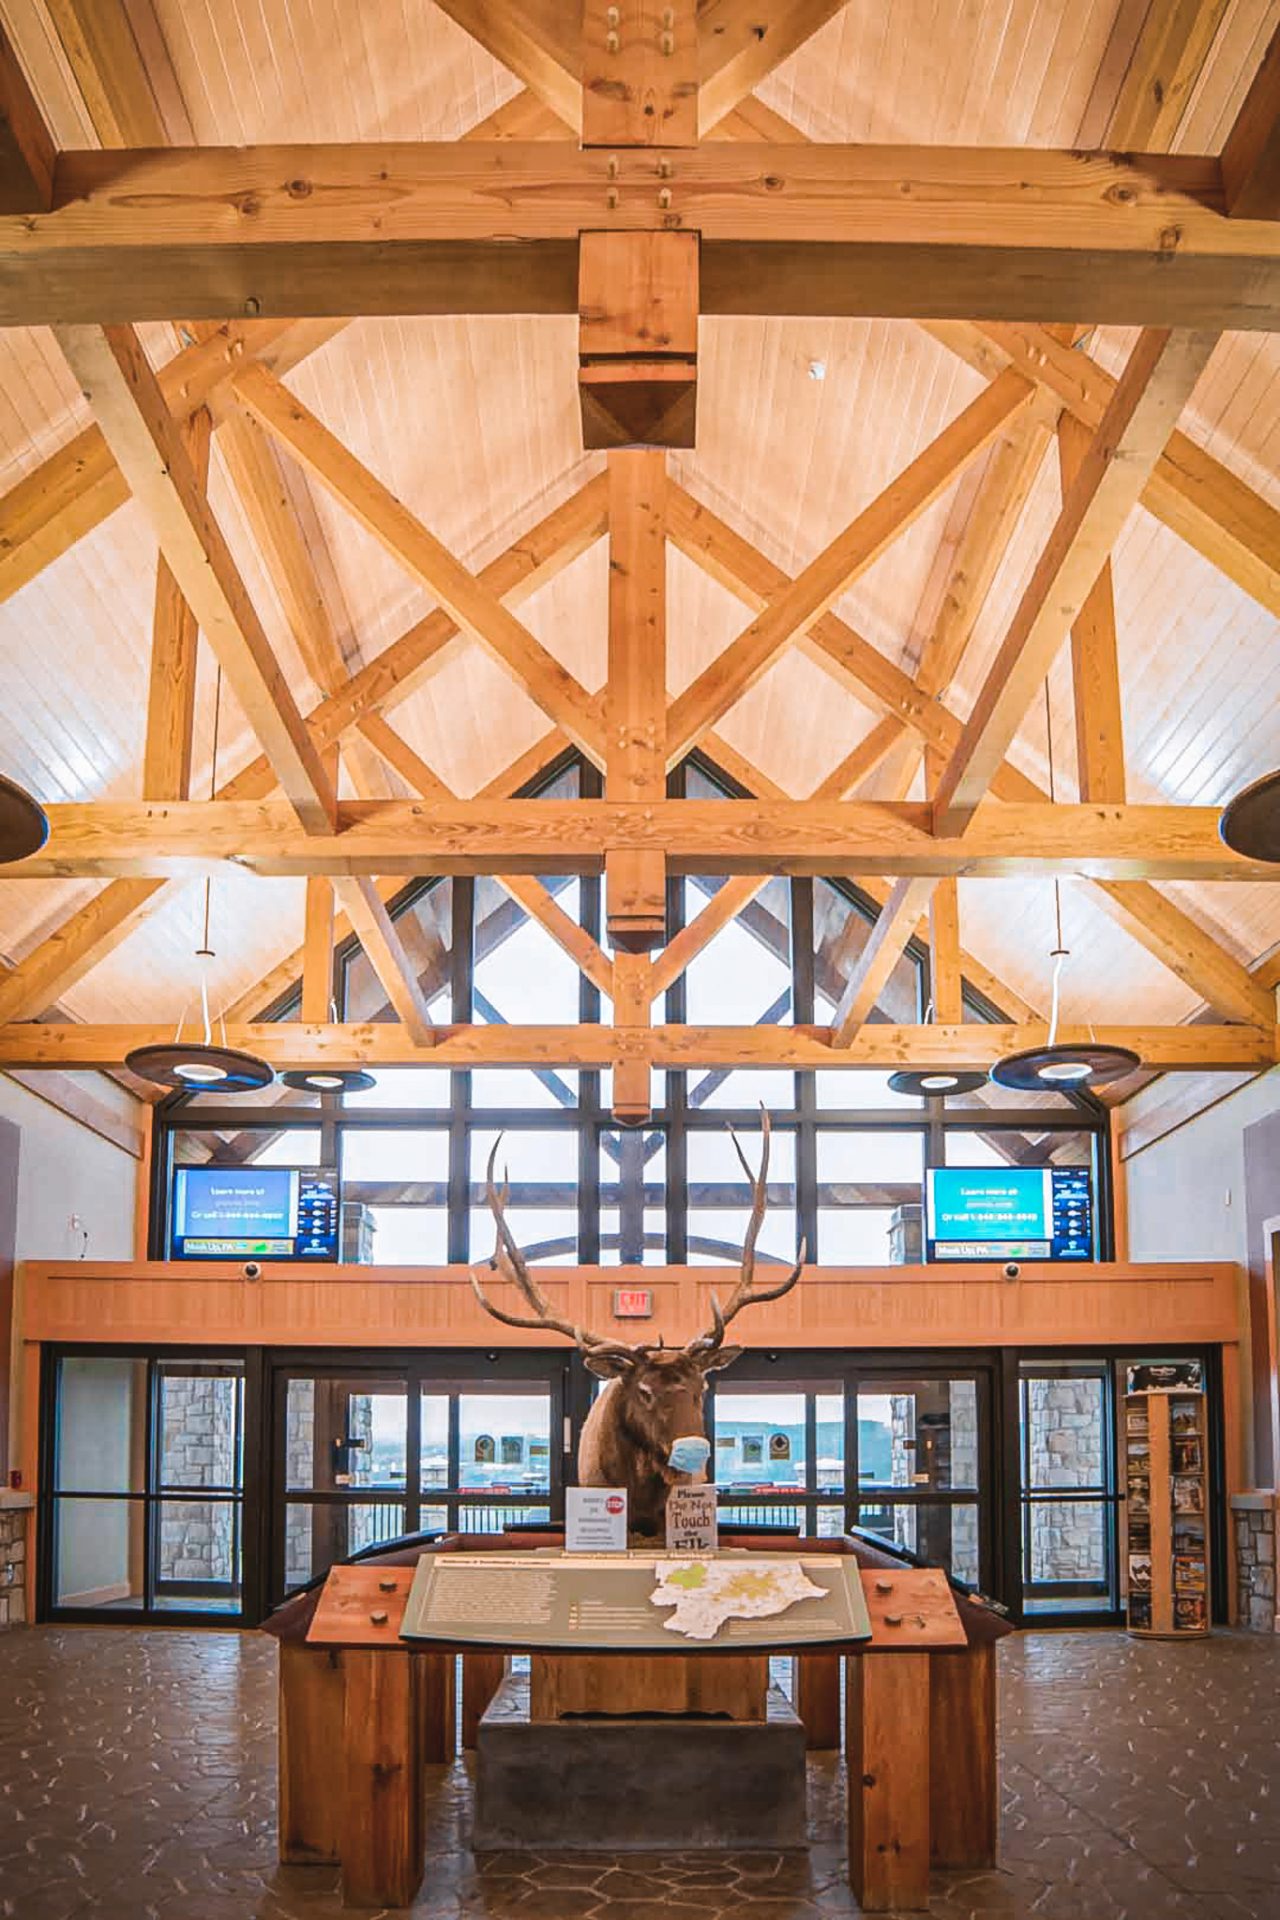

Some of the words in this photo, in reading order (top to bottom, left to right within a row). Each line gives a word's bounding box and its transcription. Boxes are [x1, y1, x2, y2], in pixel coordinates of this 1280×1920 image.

[620, 1292, 648, 1313] EXIT
[677, 1488, 706, 1499] Please
[669, 1500, 688, 1511] Do
[692, 1500, 713, 1511] Not
[672, 1511, 711, 1529] Touch
[672, 1537, 711, 1550] Elk
